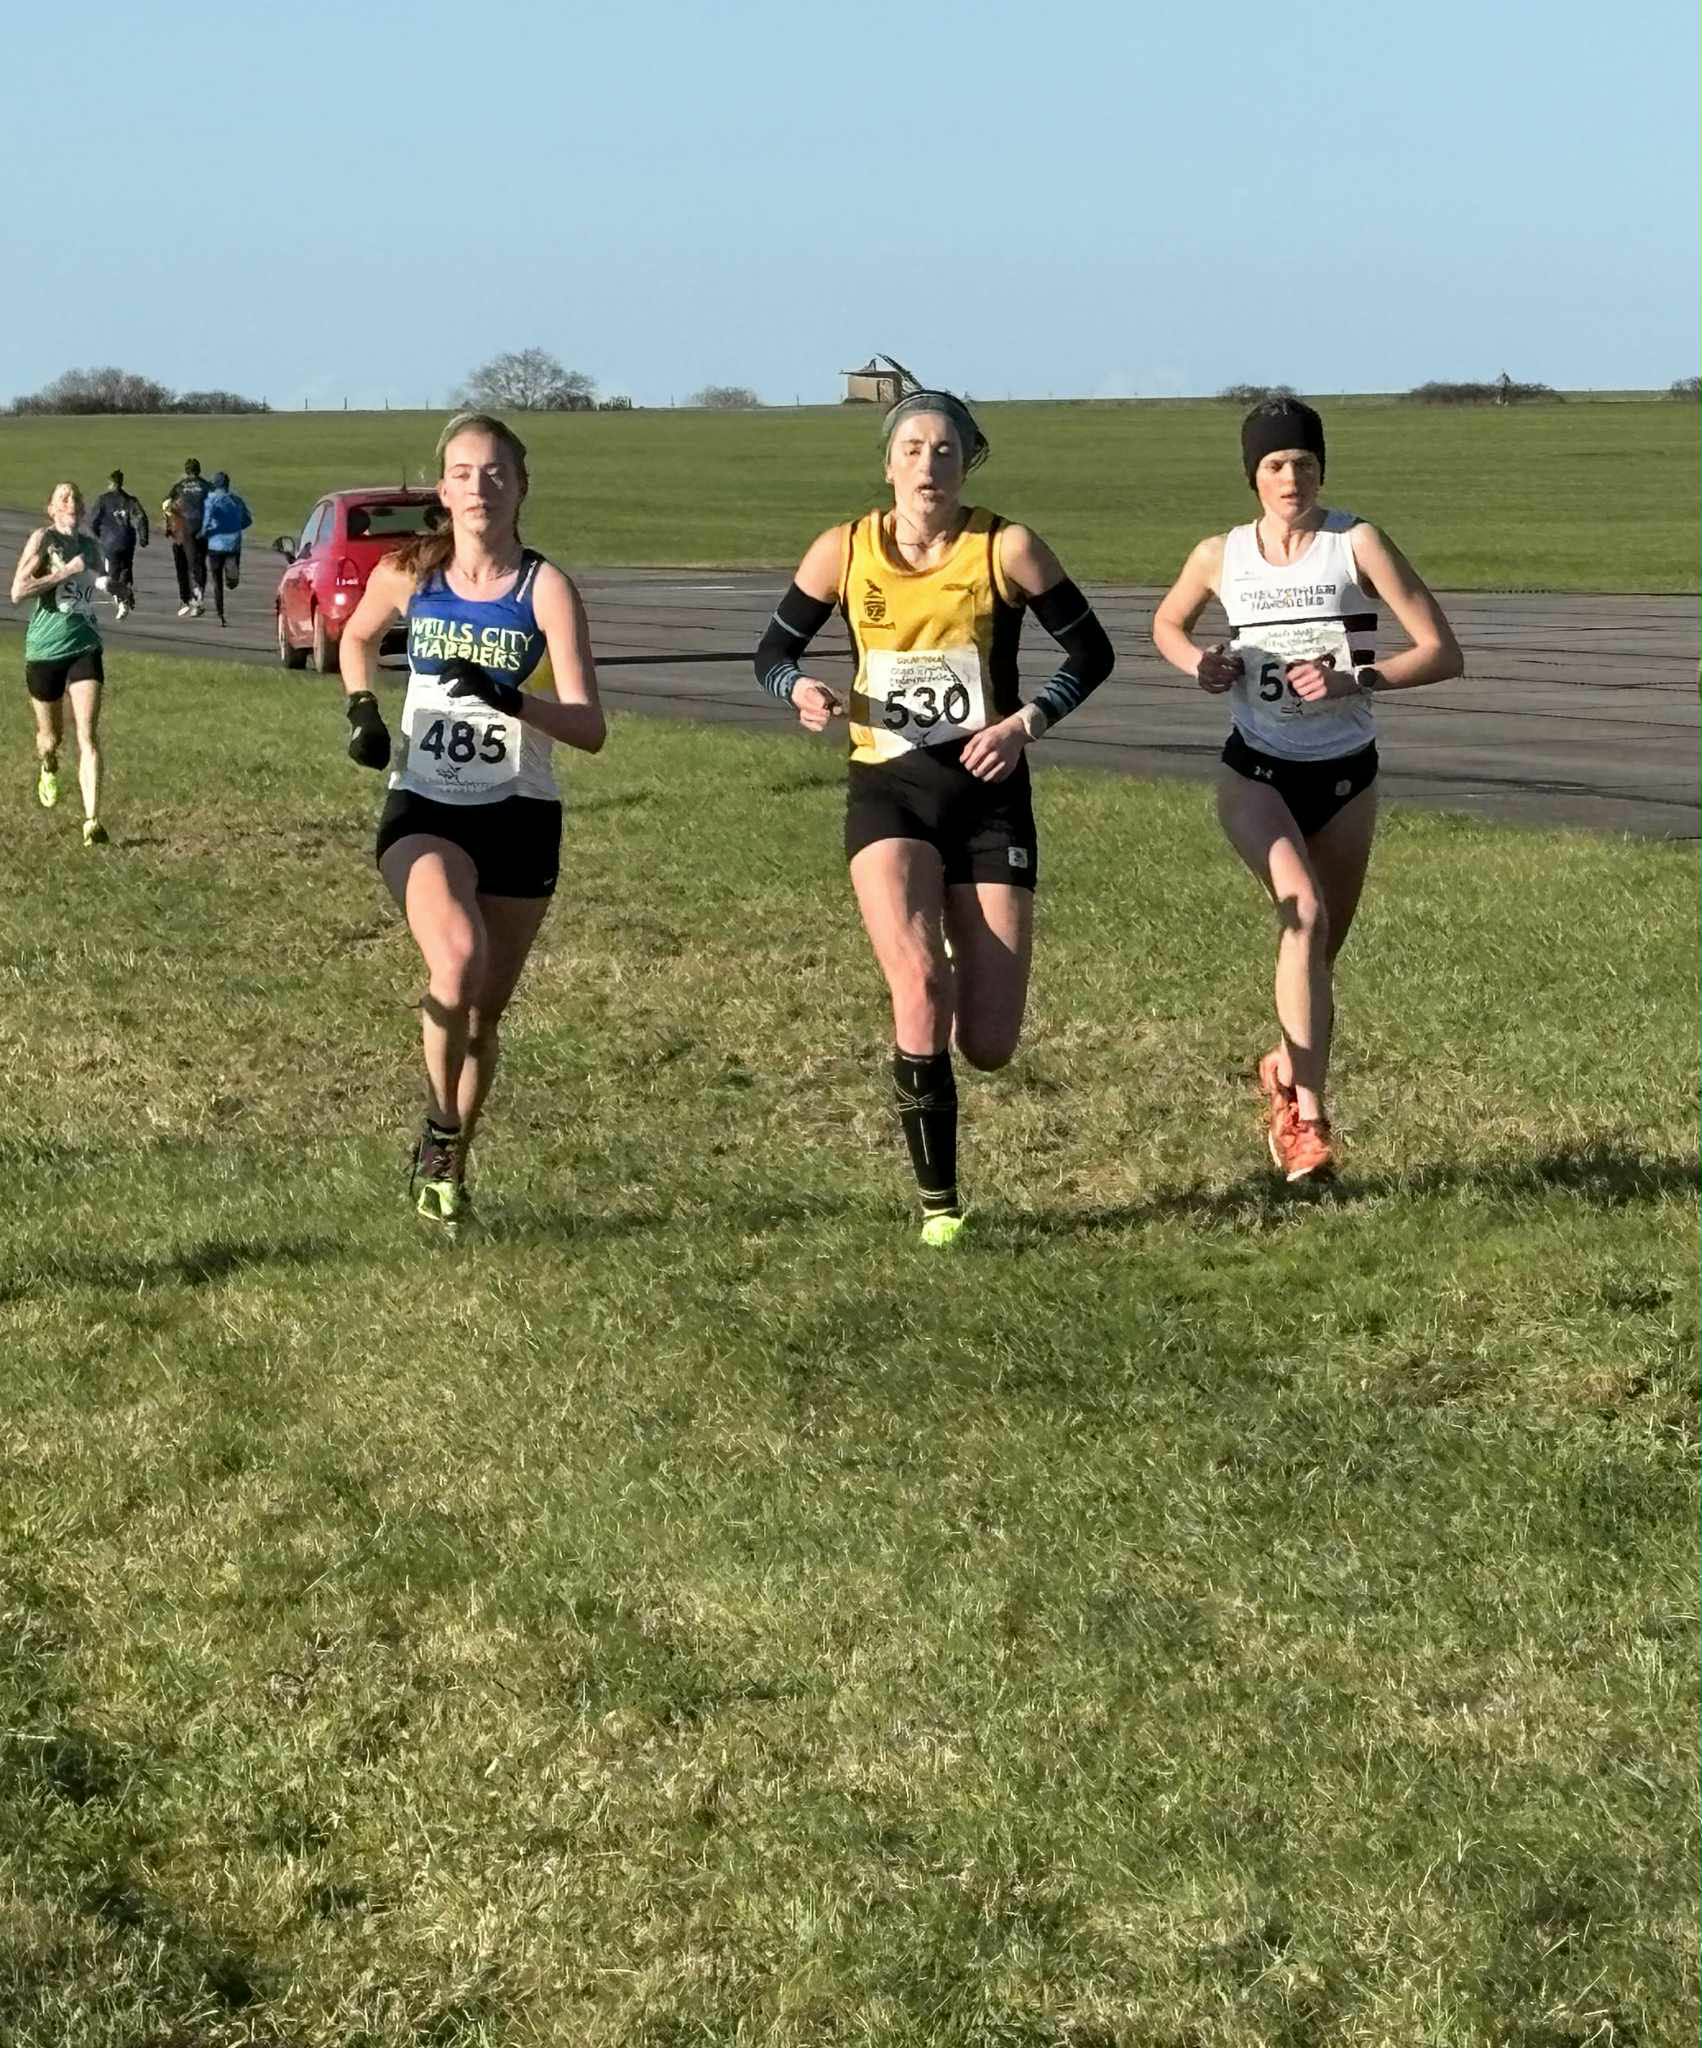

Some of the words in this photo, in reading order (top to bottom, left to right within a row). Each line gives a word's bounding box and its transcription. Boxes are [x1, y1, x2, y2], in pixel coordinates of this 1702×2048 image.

[481, 627, 535, 651] CITY
[881, 683, 970, 728] 530
[420, 719, 507, 764] 485
